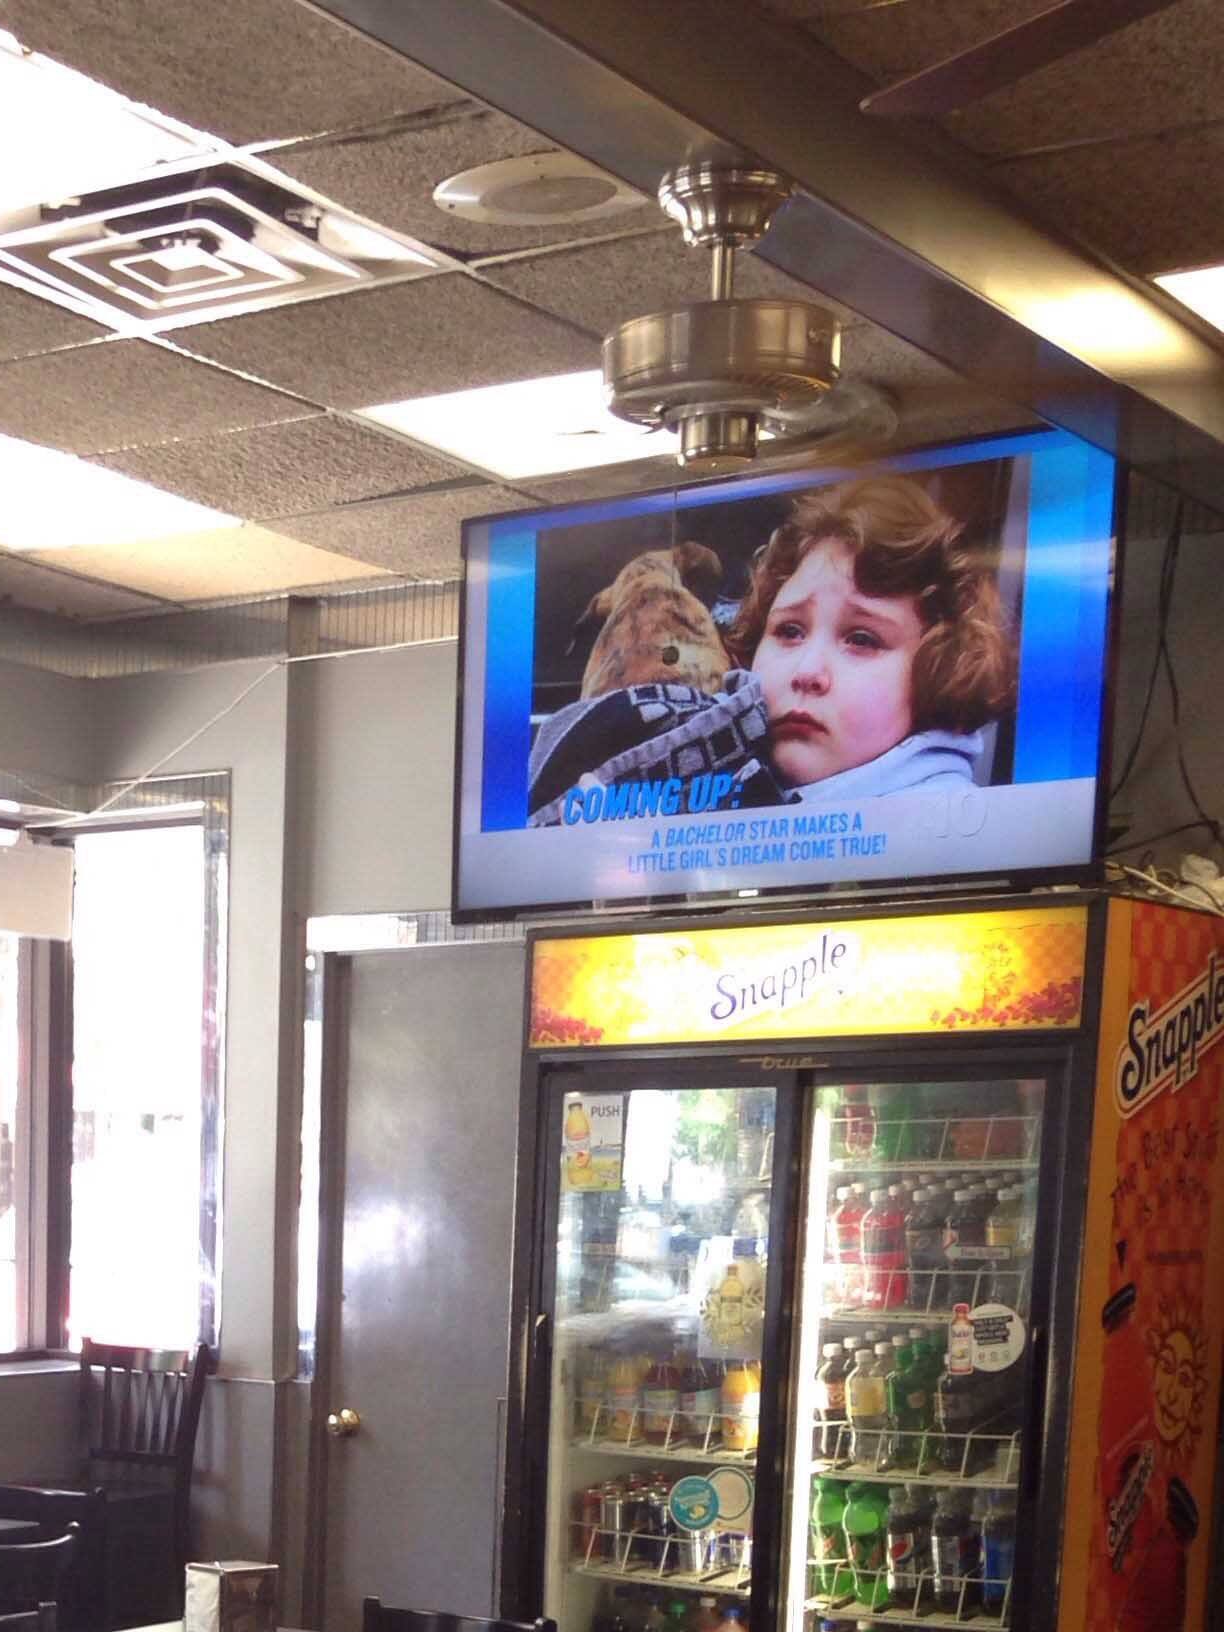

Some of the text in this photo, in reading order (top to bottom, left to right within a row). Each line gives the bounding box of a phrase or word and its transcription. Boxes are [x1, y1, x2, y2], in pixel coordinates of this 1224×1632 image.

[563, 772, 742, 825] COMING UP:
[652, 811, 862, 848] A BACHELOR STAR MAKES A
[628, 834, 887, 873] LITTLE GIRL'S DREAM COME TRUE!
[710, 933, 847, 1020] Snapple
[1121, 957, 1224, 1101] Snapple
[590, 1105, 621, 1118] PUSH
